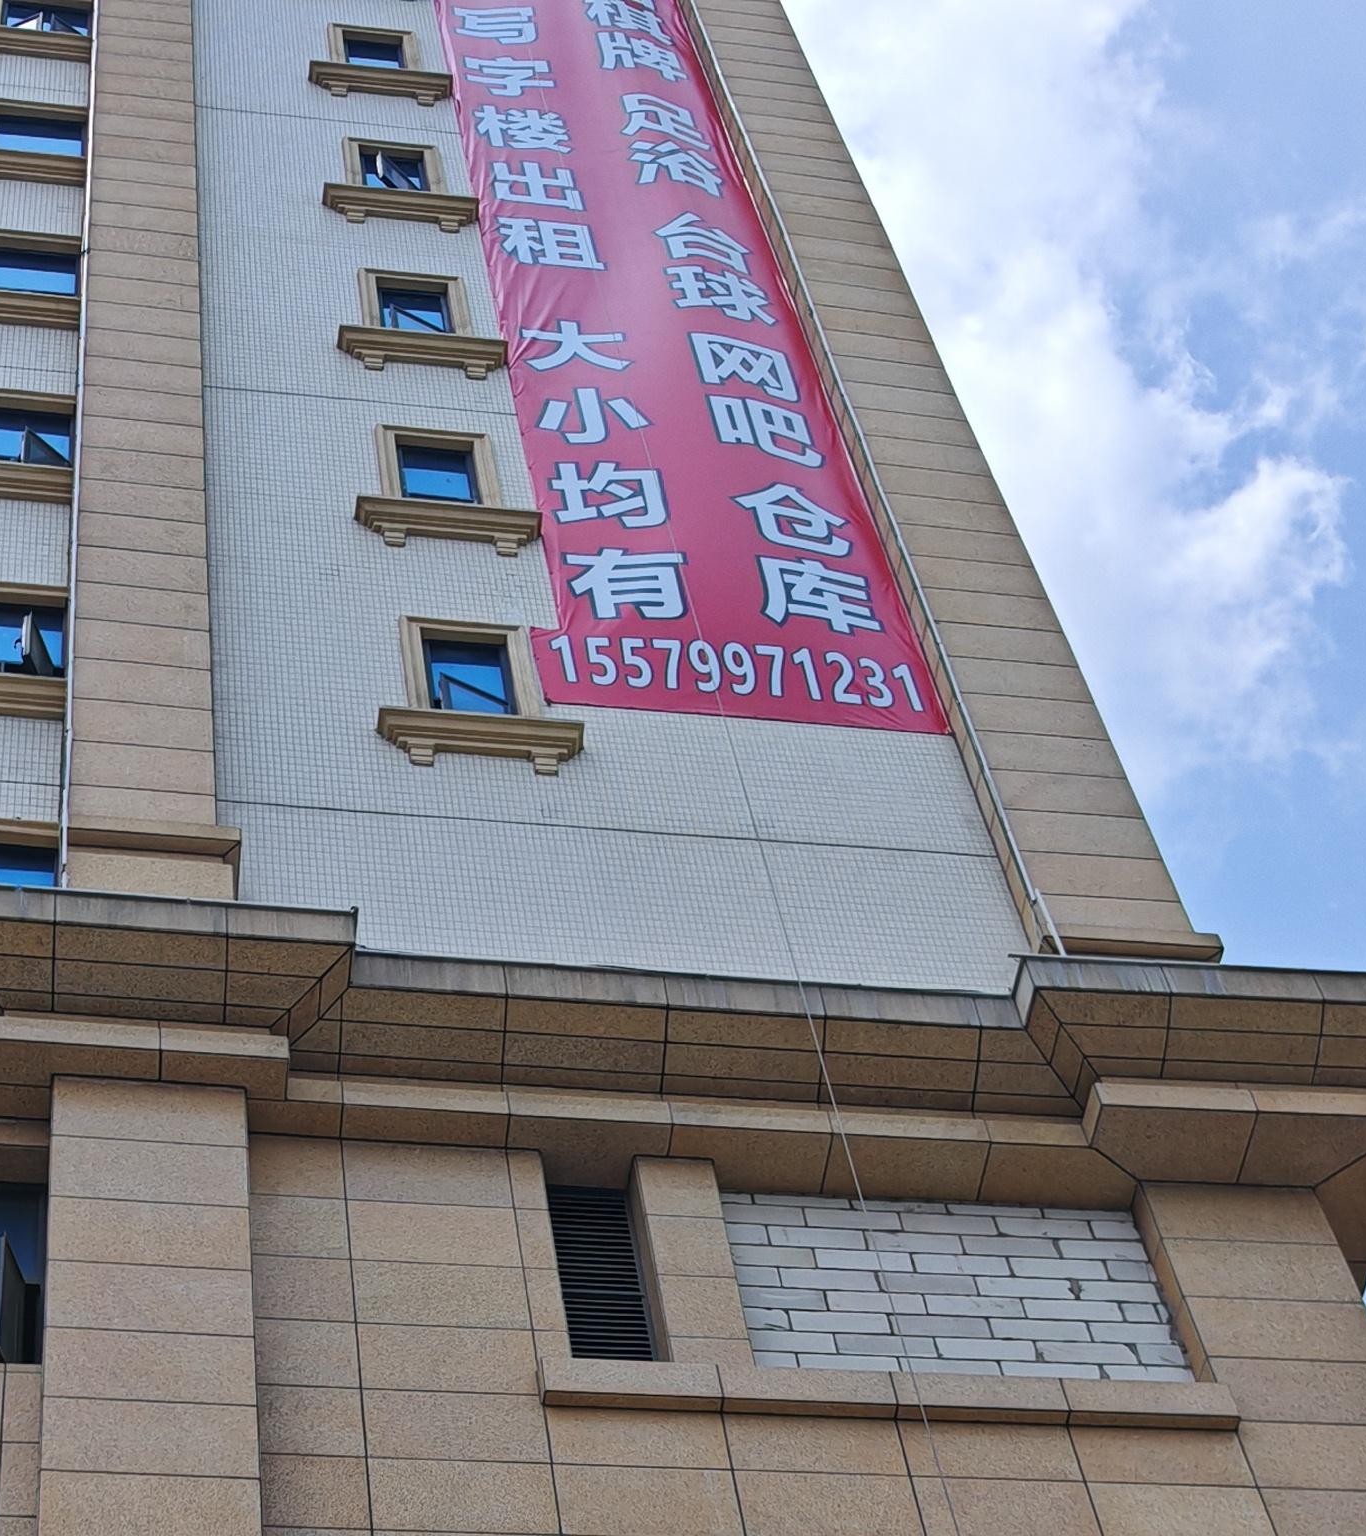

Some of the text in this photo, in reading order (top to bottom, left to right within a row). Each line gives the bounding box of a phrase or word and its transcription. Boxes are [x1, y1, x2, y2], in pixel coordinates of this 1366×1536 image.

[584, 0, 688, 82] 棋牌
[452, 6, 605, 271] 写字楼出租
[620, 92, 724, 199] 足浴
[654, 212, 779, 326] 台球
[687, 331, 826, 469] 网吧
[521, 320, 688, 620] 大小均有
[732, 482, 884, 636] 仓库
[549, 634, 924, 713] 15579971231
